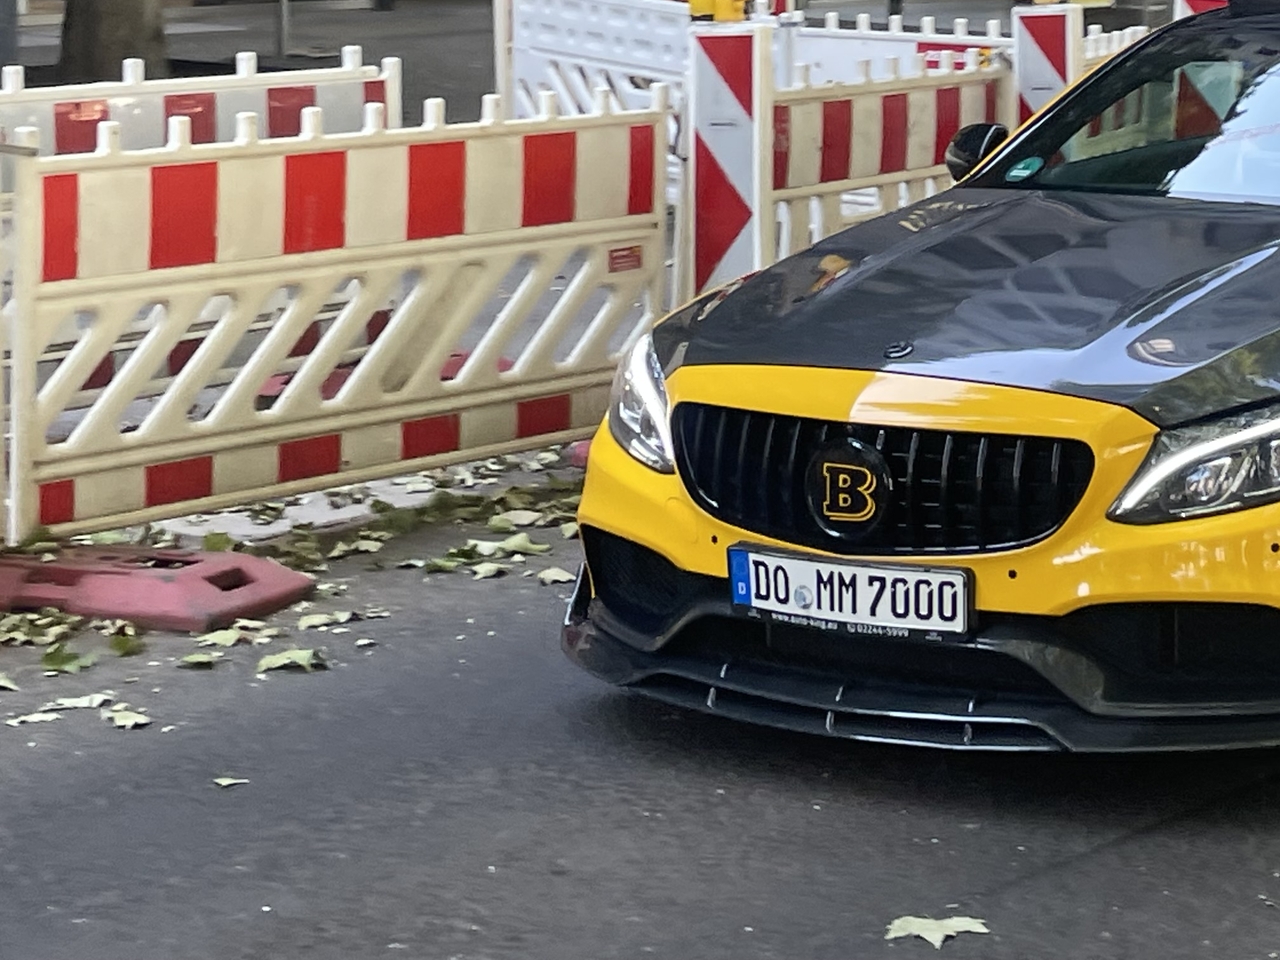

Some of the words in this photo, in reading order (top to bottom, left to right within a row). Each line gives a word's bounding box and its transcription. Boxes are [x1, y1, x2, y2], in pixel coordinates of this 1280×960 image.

[823, 462, 877, 521] B
[752, 559, 790, 605] DO
[816, 568, 858, 615] MM
[868, 575, 958, 622] 7000
